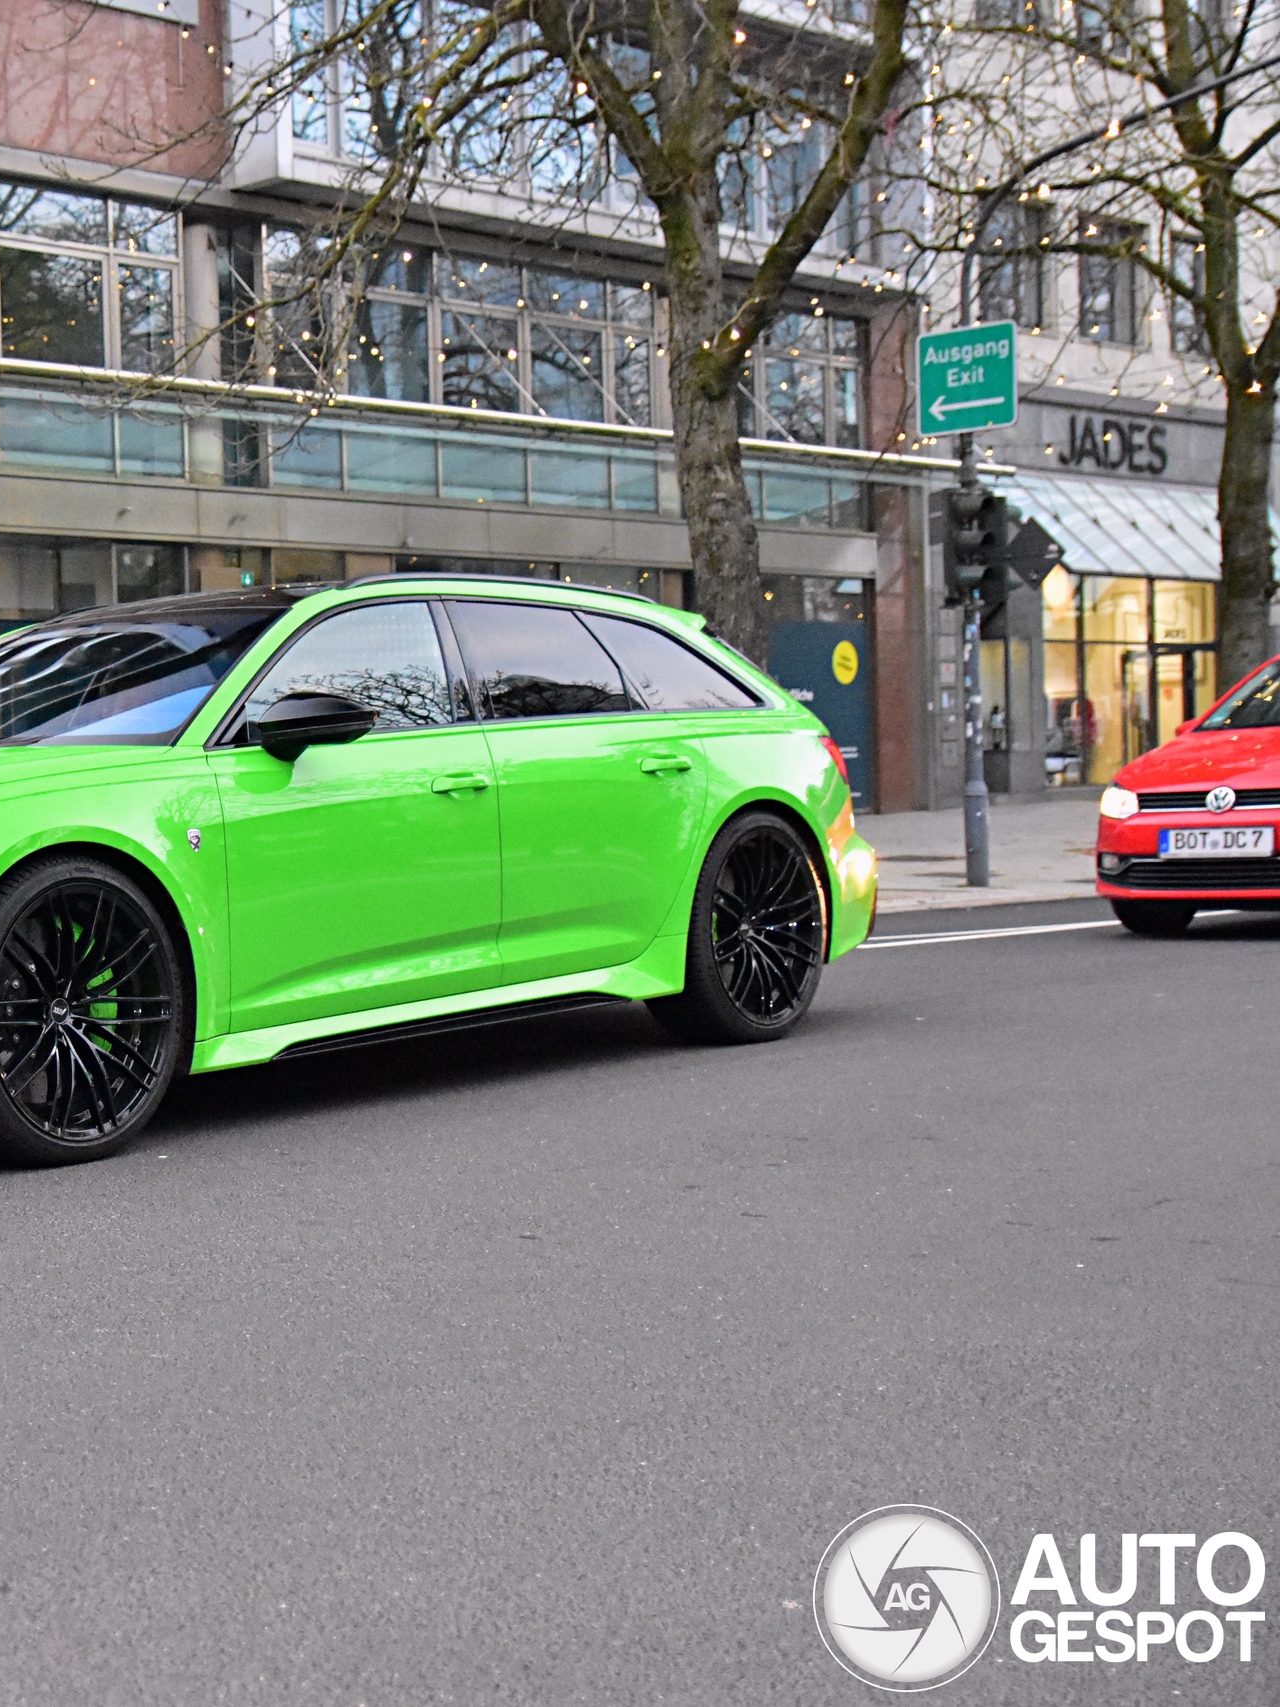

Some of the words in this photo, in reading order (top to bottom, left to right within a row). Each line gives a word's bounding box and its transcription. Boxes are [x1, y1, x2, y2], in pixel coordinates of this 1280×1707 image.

[924, 339, 1010, 366] Ausgang
[947, 365, 985, 388] Exit
[1058, 414, 1168, 475] JADES
[1174, 831, 1209, 850] BOT
[1223, 830, 1246, 849] DC
[1251, 829, 1263, 848] 7
